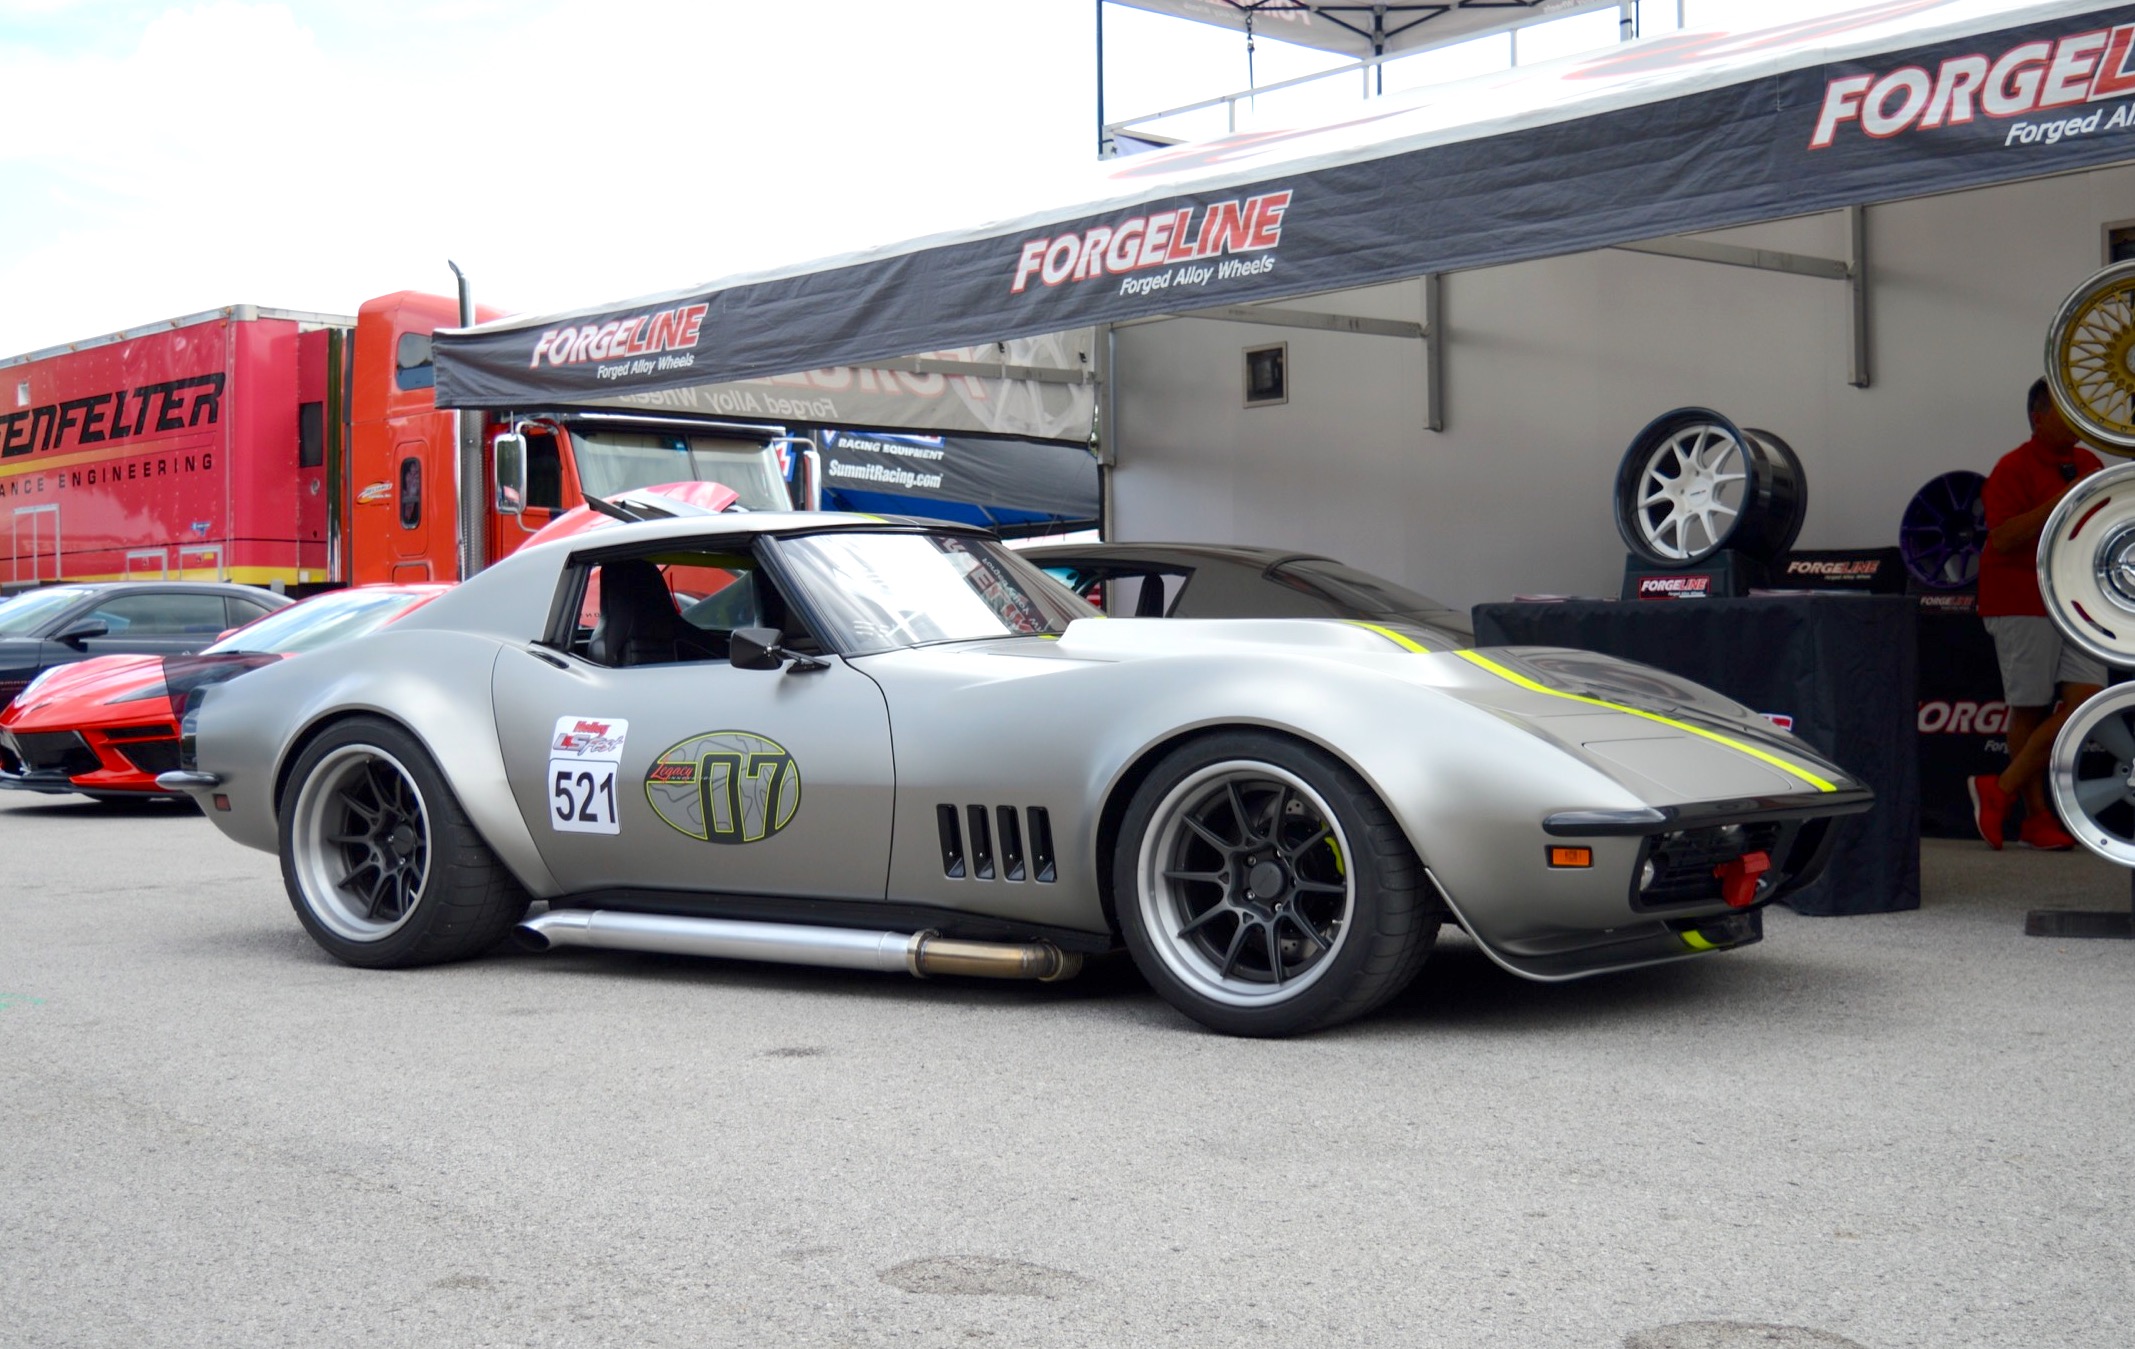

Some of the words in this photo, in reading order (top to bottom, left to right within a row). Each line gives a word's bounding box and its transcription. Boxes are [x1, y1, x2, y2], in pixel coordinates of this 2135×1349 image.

[2004, 108, 2103, 146] Forged
[2103, 101, 2135, 130] Al
[1010, 189, 1293, 294] FORGELINE
[1119, 270, 1172, 296] Forged
[1173, 265, 1213, 286] Alloy
[1217, 255, 1275, 281] Wheels
[529, 303, 709, 369] FORGELINE
[597, 360, 629, 380] Forged
[630, 360, 656, 376] Alloy
[657, 352, 695, 370] Wheels
[0, 372, 225, 458] ENFELTER
[838, 437, 880, 453] RACING
[882, 443, 944, 460] EQUIPMENT
[59, 453, 213, 489] ENGINEERING
[828, 459, 944, 488] SummitRacing.com
[1641, 577, 1708, 592] FORGELINE
[1787, 560, 1880, 574] FORGELINE
[650, 753, 694, 784] Legacy
[555, 770, 616, 824] 521
[698, 752, 788, 845] 07
